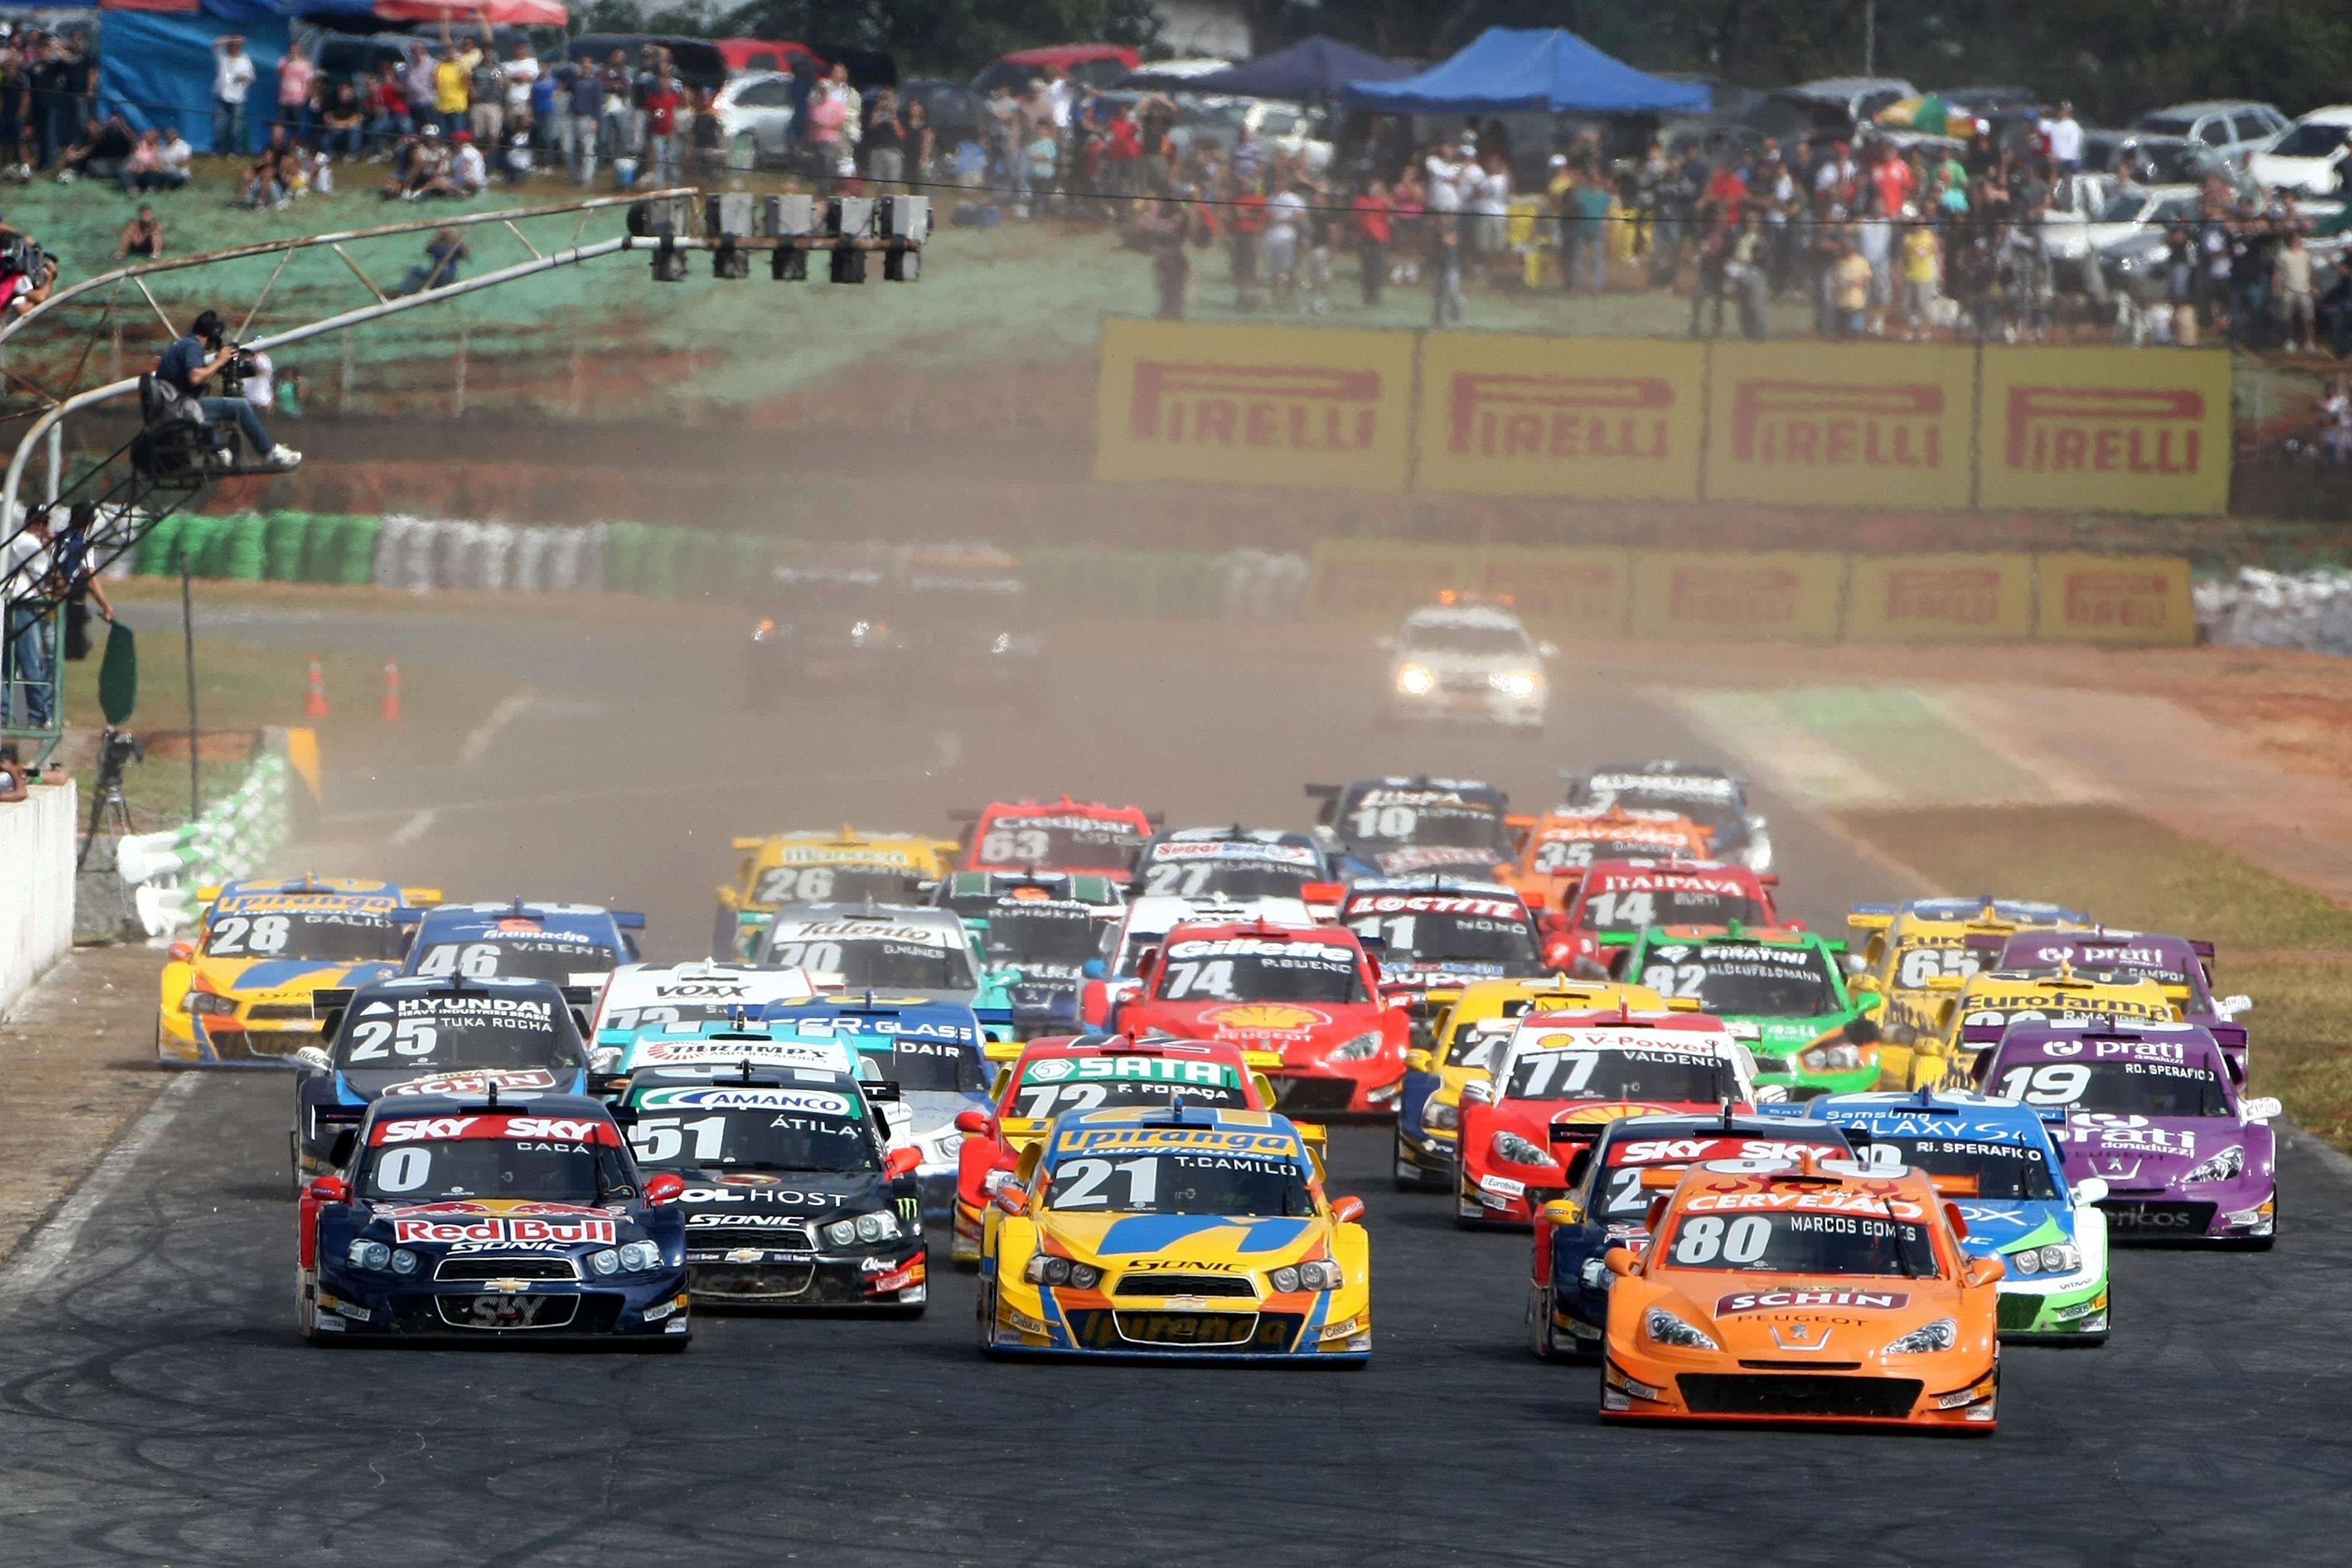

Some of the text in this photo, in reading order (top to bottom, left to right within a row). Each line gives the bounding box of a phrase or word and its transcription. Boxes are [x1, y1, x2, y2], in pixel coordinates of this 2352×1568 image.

[1132, 359, 1382, 452] PIRELLI
[1446, 370, 1676, 459] PIRELLI
[1733, 379, 1945, 469] PIRELLI
[2007, 385, 2205, 474] PIRELLI
[1348, 806, 1417, 838] 10
[979, 829, 1050, 863] 63
[759, 866, 834, 902] 26
[1606, 875, 1743, 897] ITAIPAVA
[1349, 896, 1520, 918] LOCTITE
[1586, 892, 1656, 926] 14
[209, 915, 291, 955] 28
[798, 921, 932, 939] Talento
[1347, 915, 1417, 950] 11
[417, 943, 501, 977] 46
[1167, 938, 1354, 962] Gillette
[1166, 960, 1235, 999] 74
[1902, 949, 1980, 989] 65
[656, 985, 754, 998] VOXX
[397, 998, 551, 1016] HYUNDAI
[1964, 992, 2169, 1022] Eurofarma
[440, 1018, 553, 1033] TUKA ROCHA
[349, 1018, 438, 1062] 25
[2096, 1040, 2184, 1057] prati
[1078, 1056, 1221, 1085] SATA
[1521, 1051, 1600, 1097] 77
[396, 1073, 542, 1096] SCHIN
[1117, 1085, 1229, 1100] F. FOGAÇA
[2002, 1063, 2092, 1105] 19
[712, 1094, 843, 1111] AMANCO
[1826, 1111, 1930, 1123] Samsung
[1828, 1119, 1968, 1137] ALAXY
[382, 1117, 601, 1143] SKY SKY
[628, 1116, 727, 1162] 51
[1065, 1129, 1292, 1150] Ipiranga
[517, 1140, 590, 1155] CACÁ
[1082, 1146, 1275, 1161] Lubrificantes
[1621, 1140, 1720, 1162] SKY
[1739, 1141, 1835, 1161] SKY
[1942, 1142, 2042, 1161] SPERAFICO
[2100, 1142, 2195, 1159] donaduzzi
[377, 1146, 432, 1192] 0
[1174, 1156, 1296, 1177] T.CAMILO
[1053, 1157, 1158, 1209] 21
[662, 1189, 849, 1207] OL HOST
[395, 1218, 616, 1244] Red Bull
[685, 1214, 805, 1228] SONIC
[1790, 1216, 1857, 1235] MARCOS
[446, 1241, 570, 1256] SONIC
[1676, 1215, 1772, 1264] 80
[1128, 1258, 1248, 1273] SONIC
[1731, 1292, 1893, 1310] SCHIN
[1737, 1315, 1869, 1327] PEUGEOT
